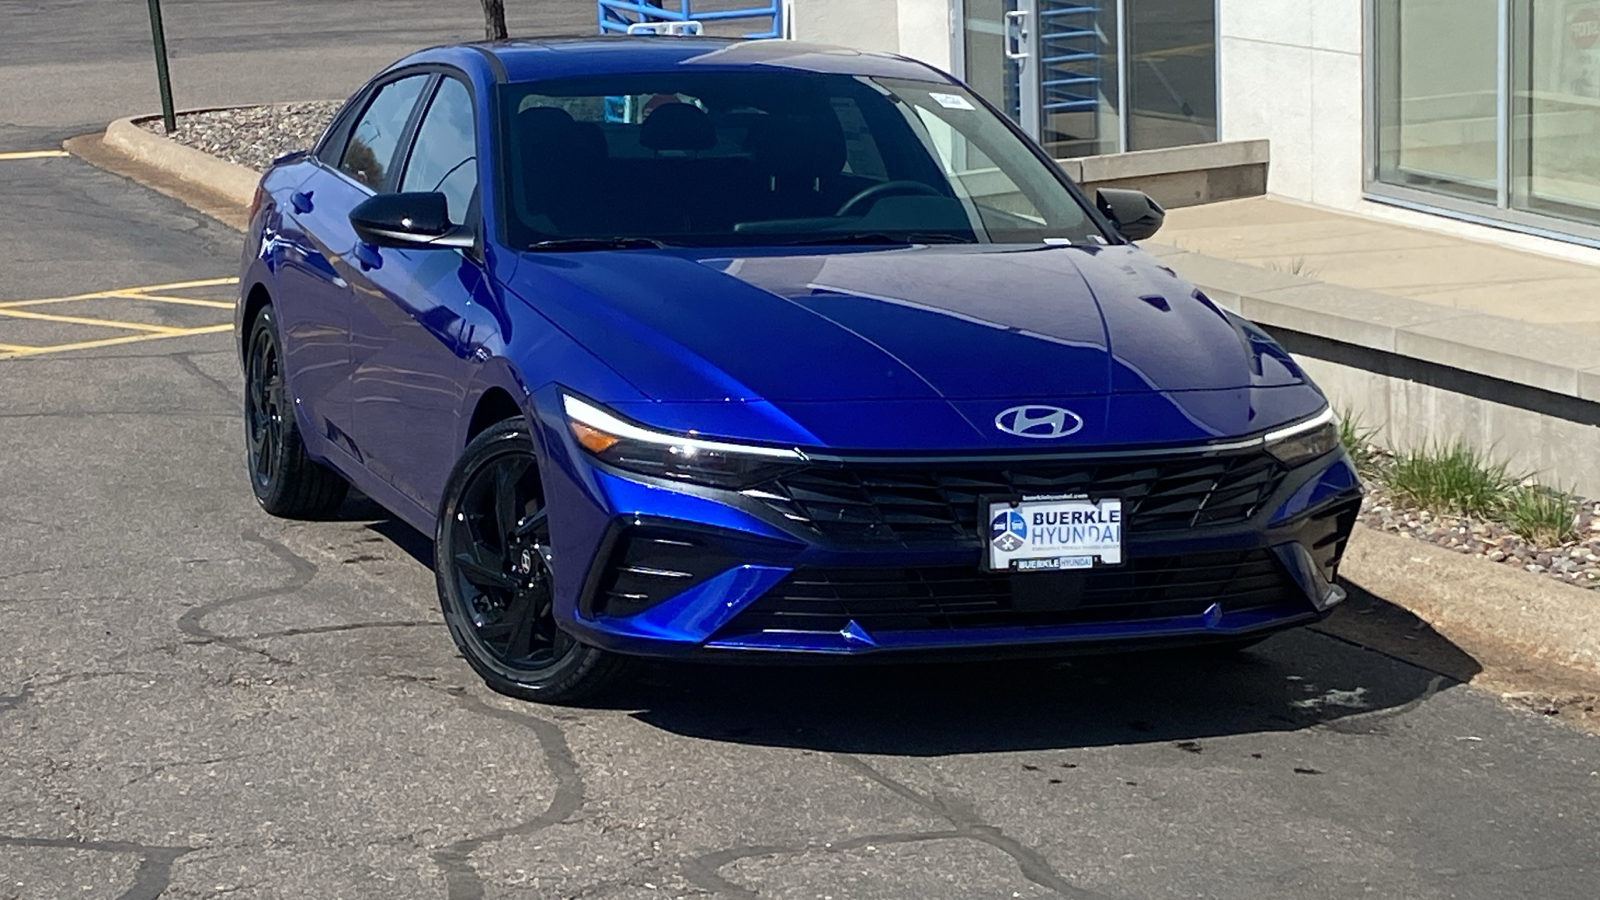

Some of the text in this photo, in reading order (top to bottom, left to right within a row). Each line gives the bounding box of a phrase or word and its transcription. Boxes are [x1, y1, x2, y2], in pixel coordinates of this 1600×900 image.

[1032, 510, 1120, 526] BUERKLE
[1031, 525, 1120, 545] HYUNDAI
[1018, 556, 1092, 569] BUERKLE HYUNDAI
